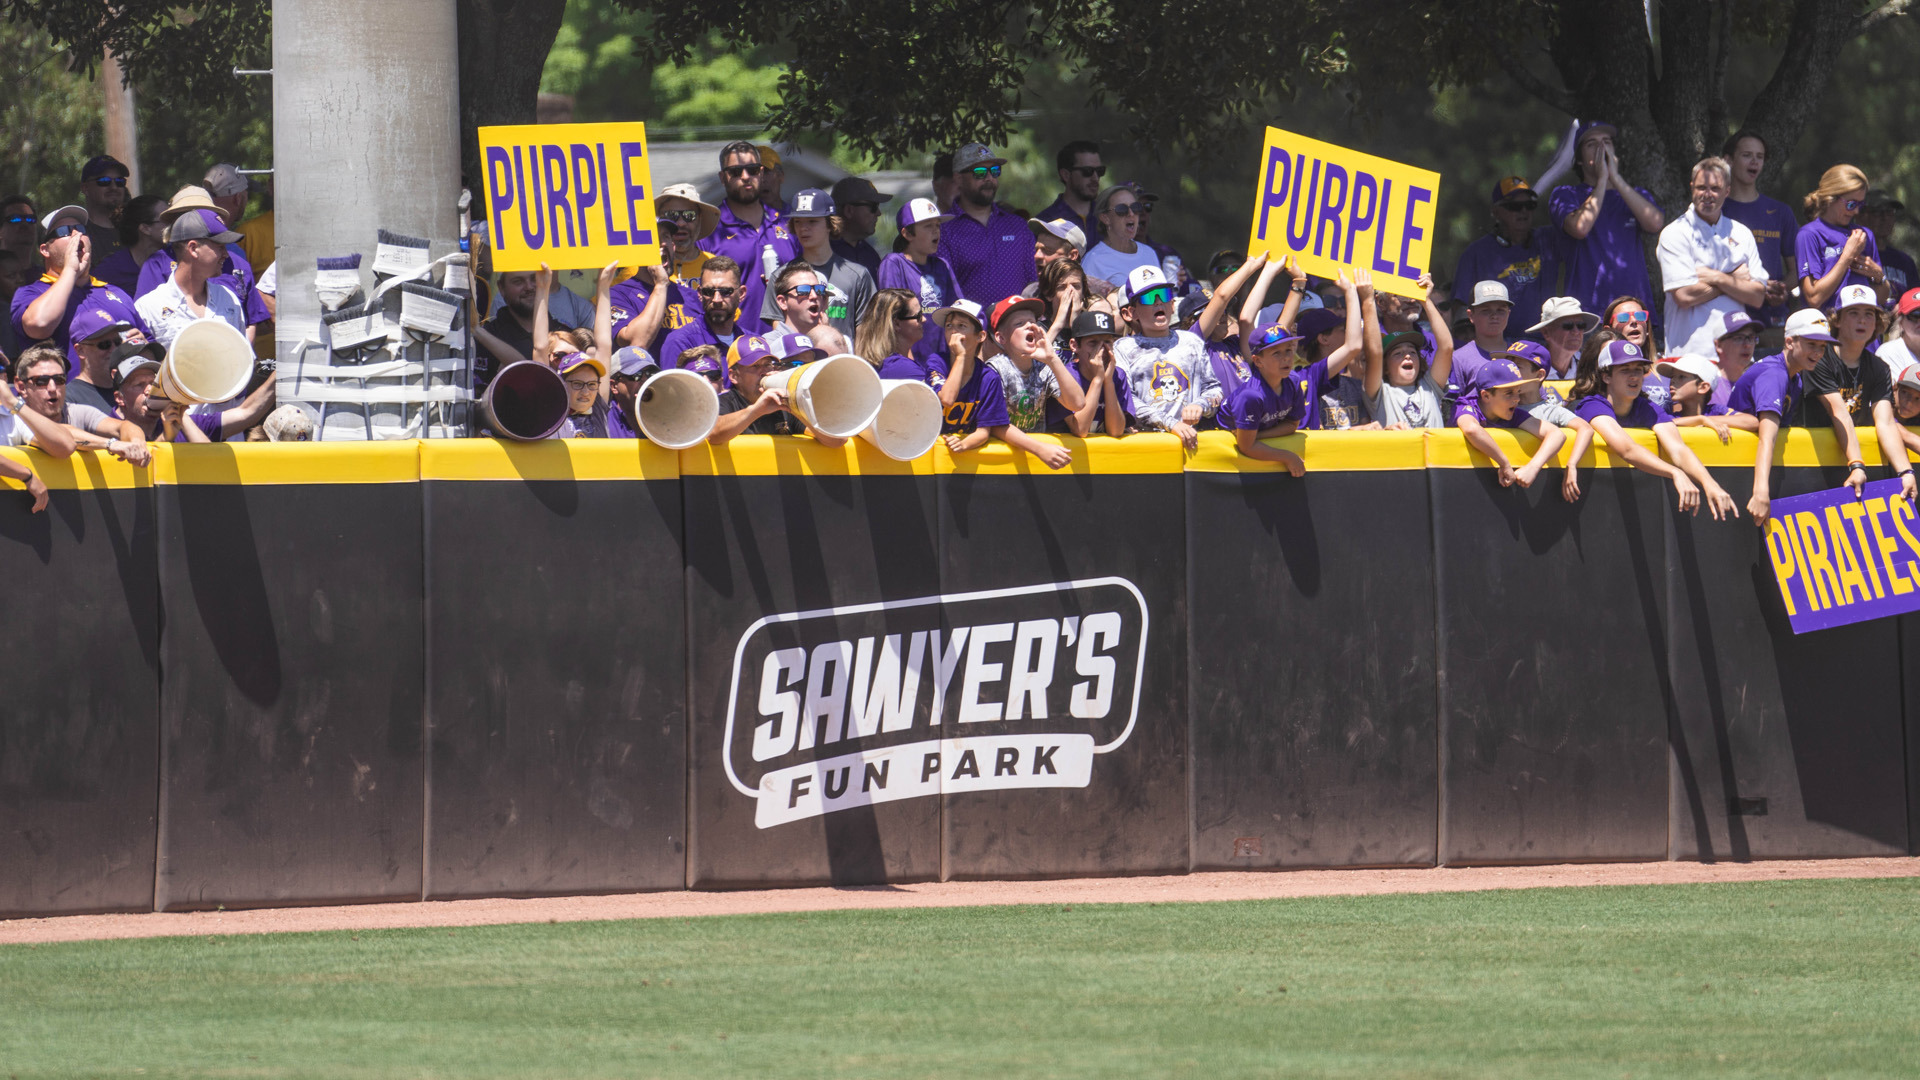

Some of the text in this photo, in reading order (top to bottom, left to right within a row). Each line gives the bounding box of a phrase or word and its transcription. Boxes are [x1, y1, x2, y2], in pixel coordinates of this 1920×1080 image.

[486, 142, 653, 250] PURPLE
[1257, 146, 1432, 280] PURPLE
[664, 303, 684, 317] AST
[1507, 341, 1528, 352] CU
[1158, 367, 1174, 376] ECU
[942, 400, 980, 425] CU
[1325, 405, 1359, 427] ECU
[1763, 494, 1920, 616] PIRATES
[752, 611, 1122, 762] SAWYER'S
[788, 746, 1061, 809] FUN PARK
